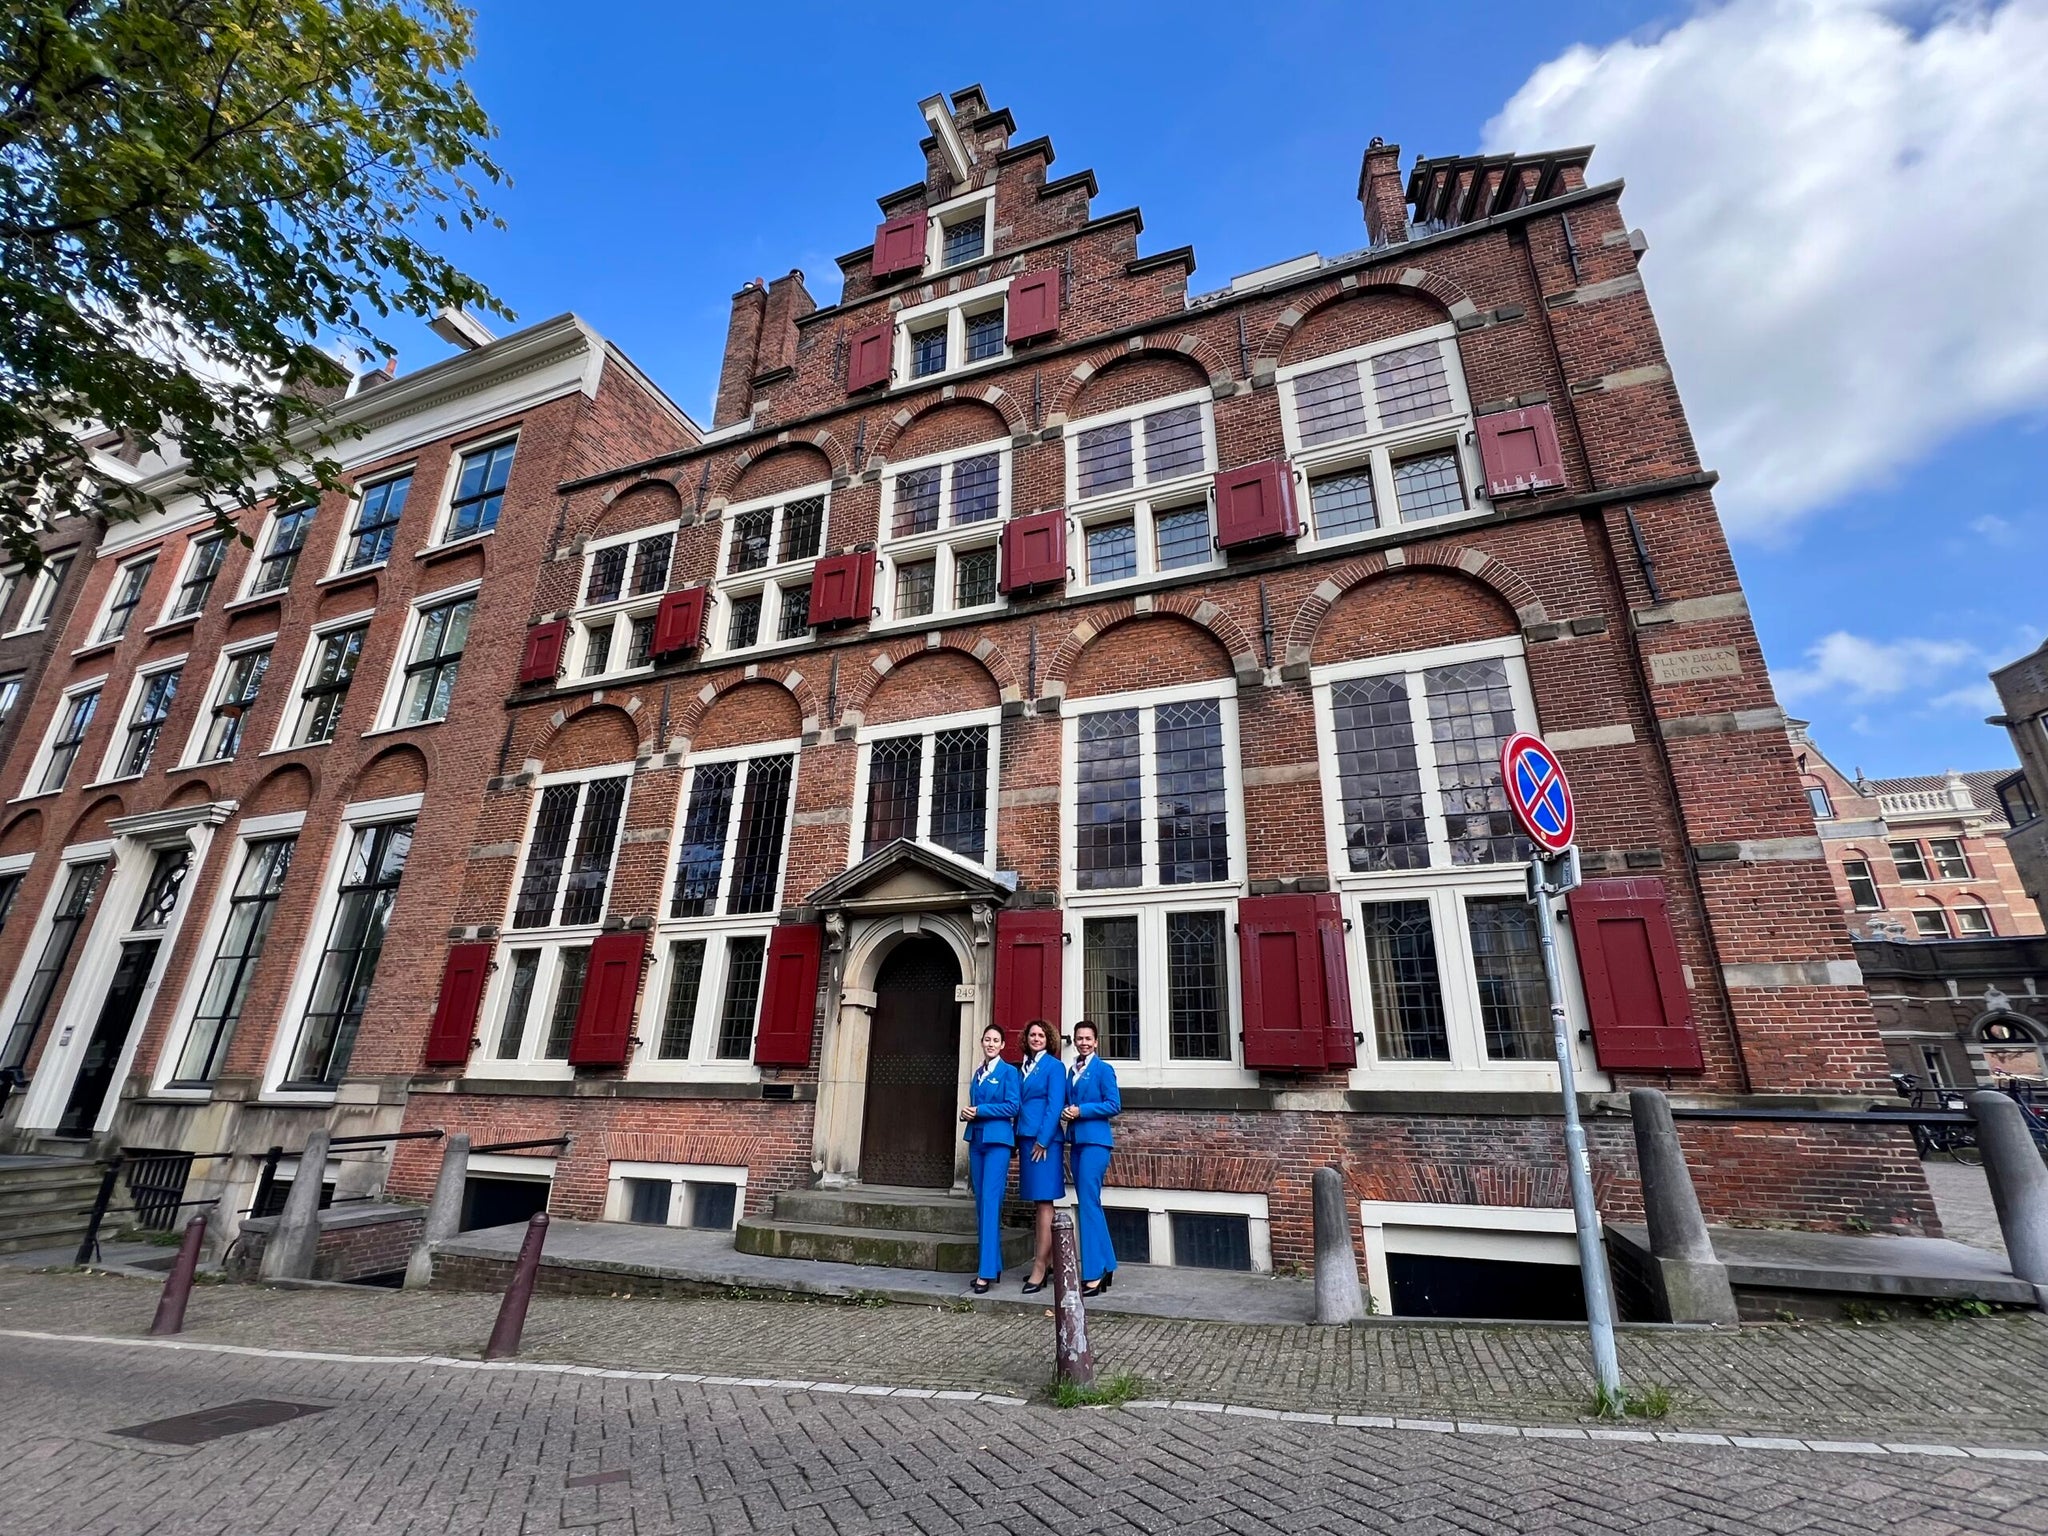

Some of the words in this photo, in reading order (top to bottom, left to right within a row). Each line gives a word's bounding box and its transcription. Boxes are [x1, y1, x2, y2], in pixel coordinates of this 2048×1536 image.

[1653, 650, 1735, 668] FLUWEELEN
[1662, 662, 1734, 679] BURGWAL
[956, 988, 975, 998] 249
